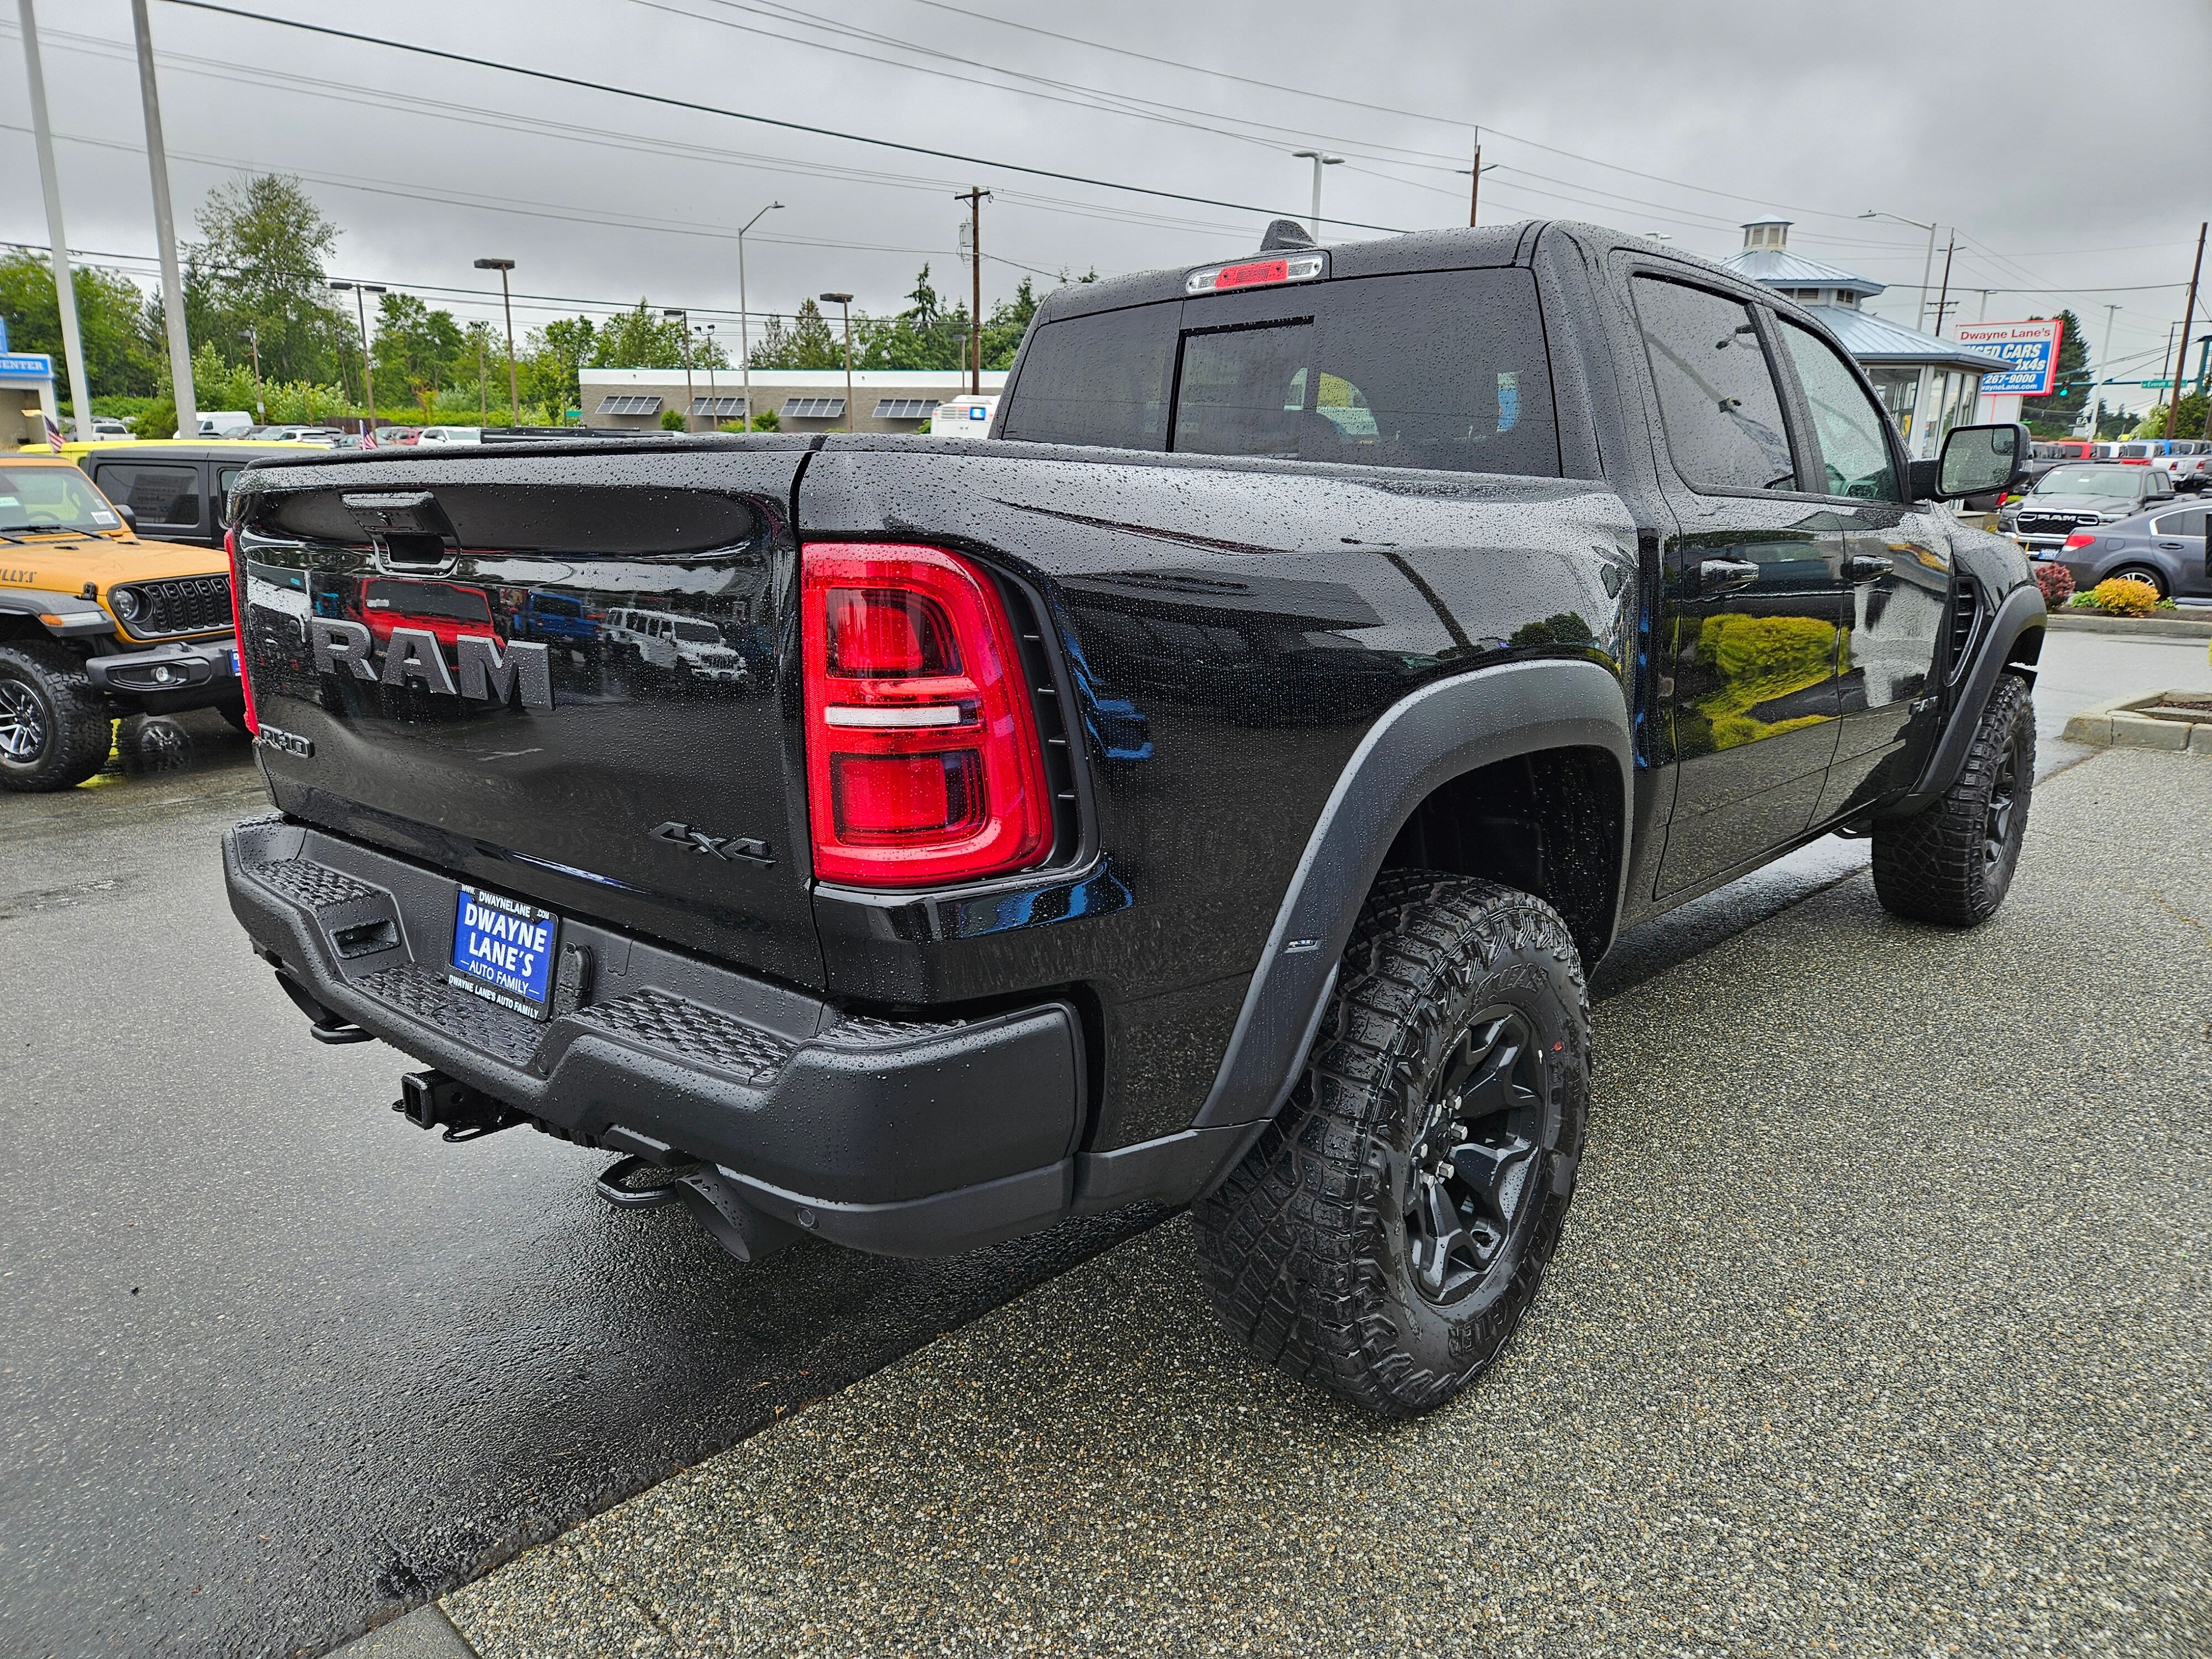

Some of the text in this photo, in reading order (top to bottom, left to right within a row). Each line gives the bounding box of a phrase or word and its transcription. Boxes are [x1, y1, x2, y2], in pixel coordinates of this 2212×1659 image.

[1960, 328, 2051, 341] Dwayne Lane's
[2002, 343, 2042, 359] CARS
[0, 360, 43, 370] ENTER
[312, 617, 556, 711] RAM
[479, 891, 531, 918] DWAYNELANE
[465, 902, 547, 953] DWAYNE
[469, 932, 534, 977] LANE'S
[469, 960, 529, 995] AUTO FAMILY
[448, 974, 540, 1020] DWAYNE LANE'S AUTO FAMILY
